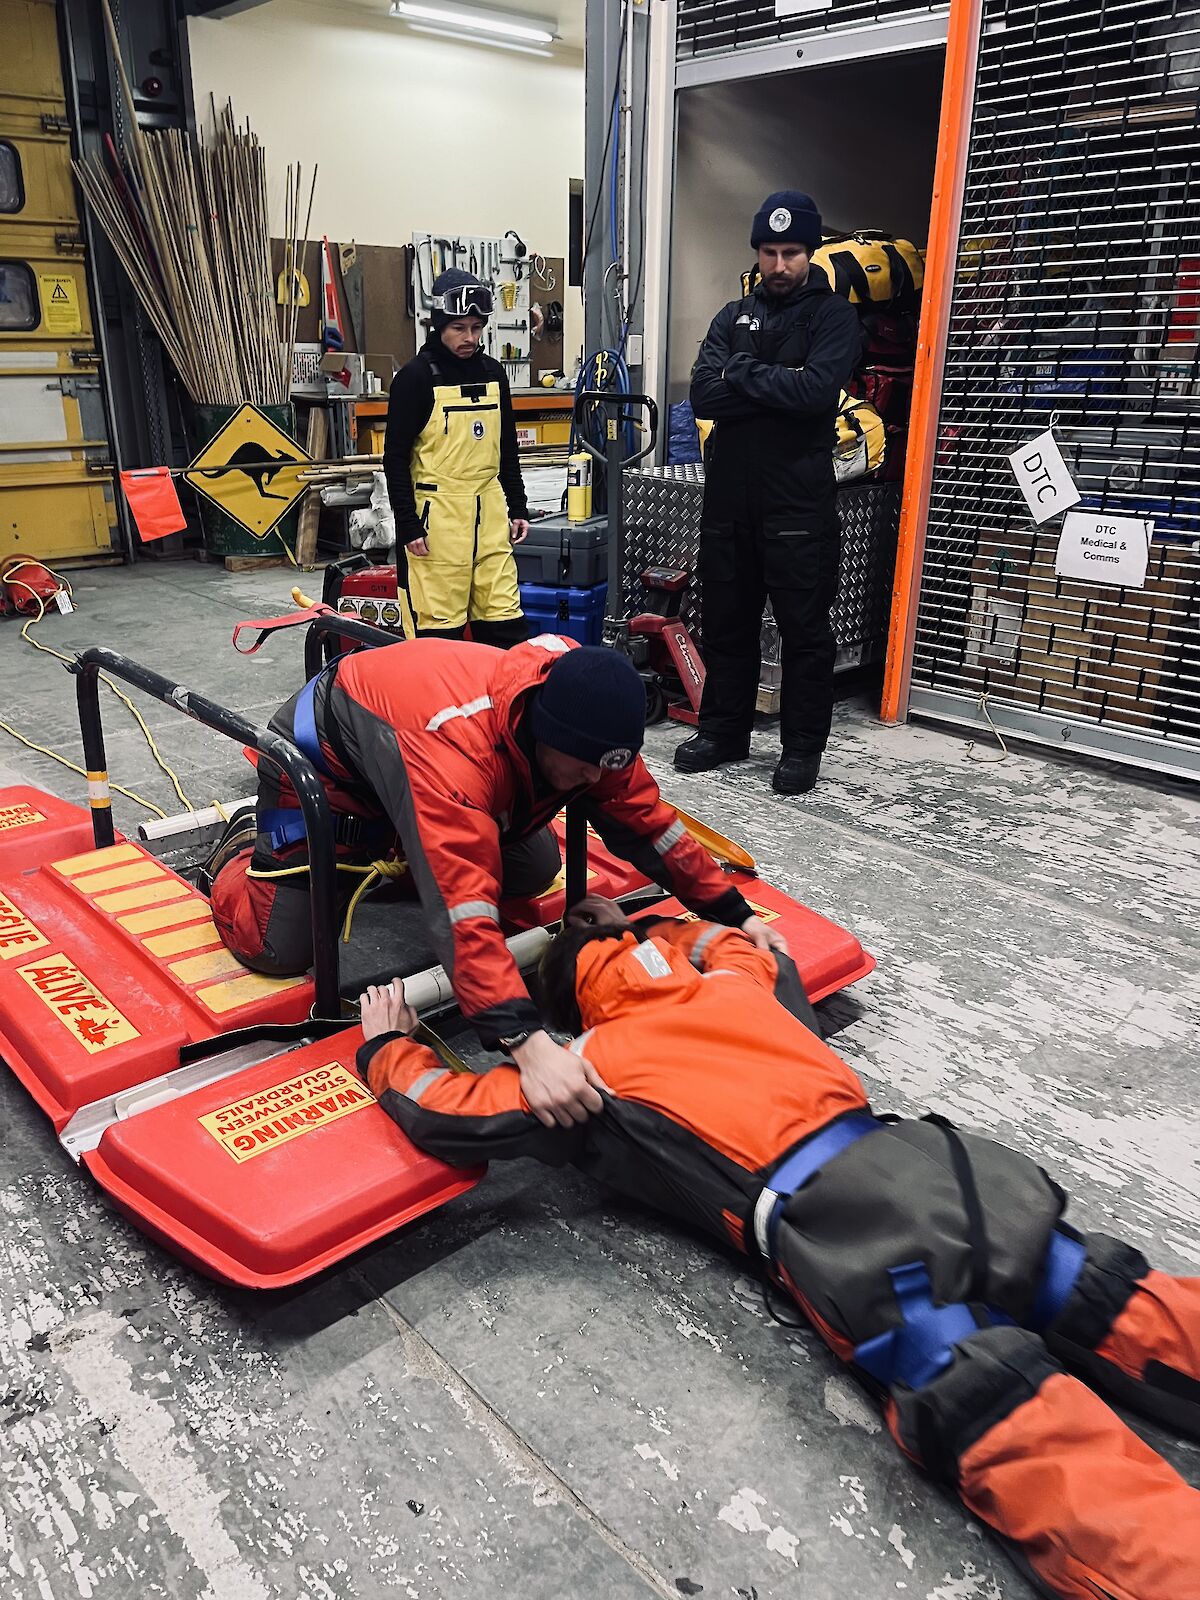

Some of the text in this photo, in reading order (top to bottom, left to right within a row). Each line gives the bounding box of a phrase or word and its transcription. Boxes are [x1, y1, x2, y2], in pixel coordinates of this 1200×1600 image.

[1023, 452, 1057, 504] DTC
[1080, 537, 1127, 551] Medical &
[1095, 525, 1117, 535] DTC
[1083, 551, 1120, 564] Comms
[24, 966, 104, 1015] ALIVE
[215, 1070, 331, 1122] GUARDRAILS
[217, 1075, 347, 1135] STAY BETWEEN
[233, 1089, 367, 1151] WARNING
